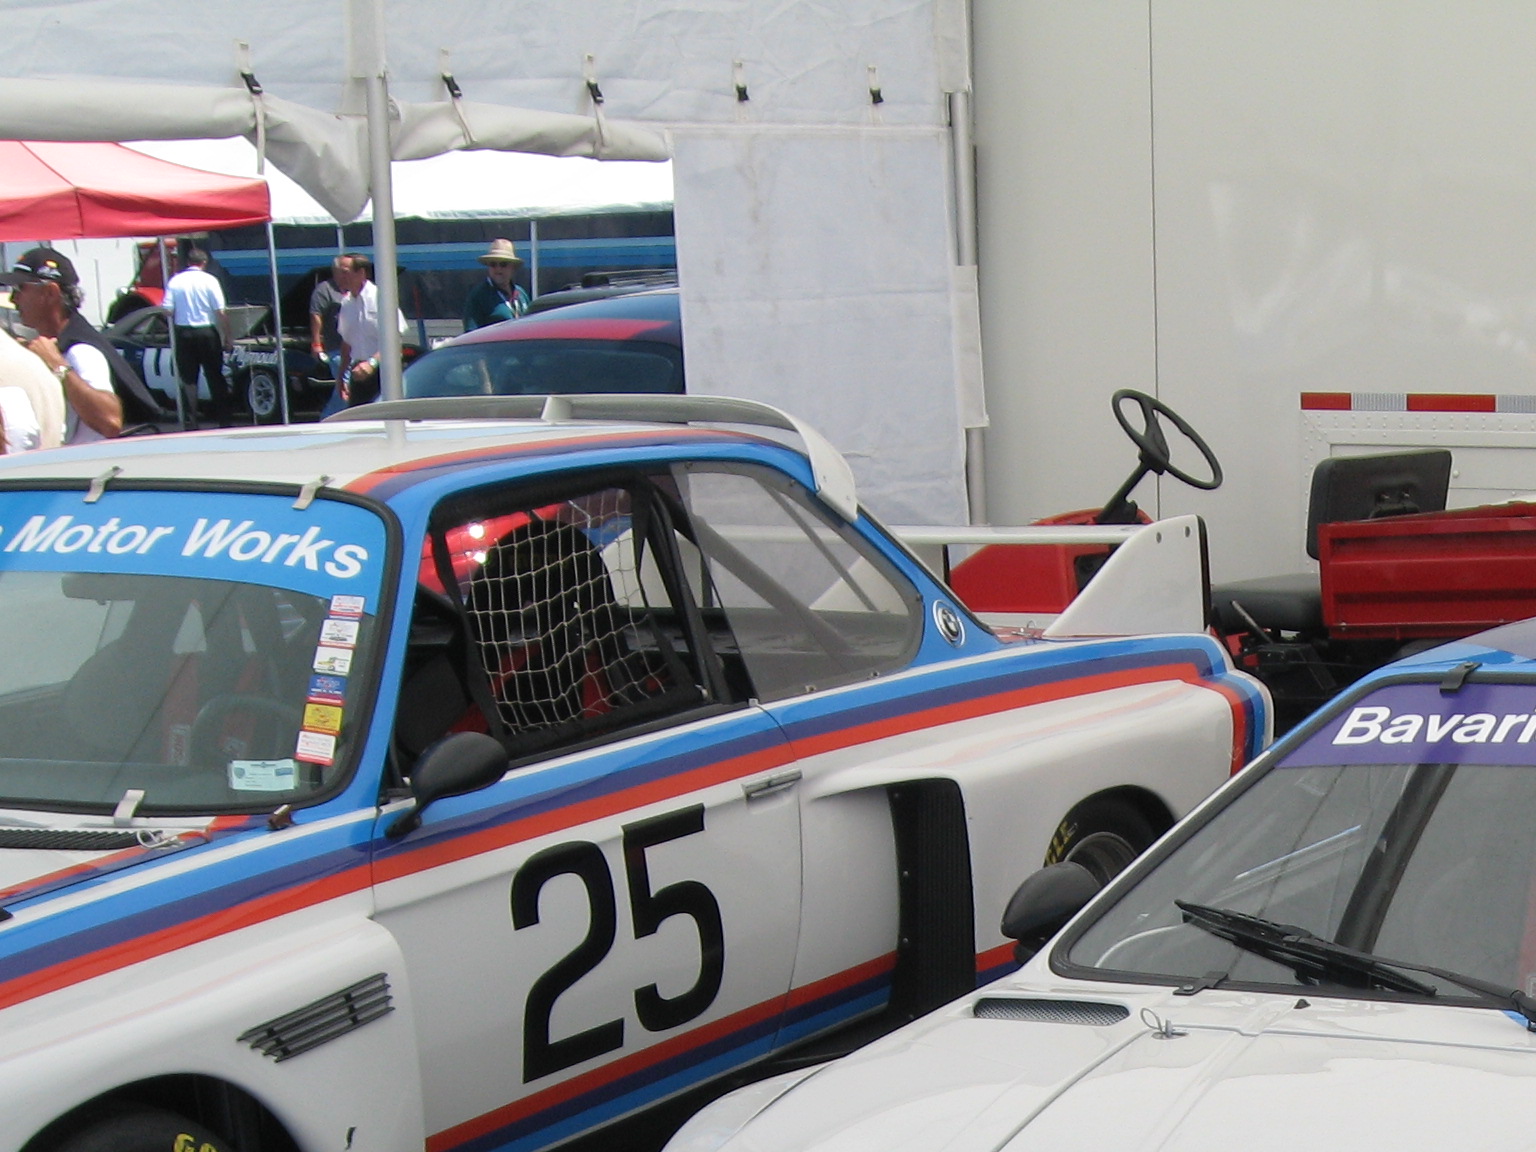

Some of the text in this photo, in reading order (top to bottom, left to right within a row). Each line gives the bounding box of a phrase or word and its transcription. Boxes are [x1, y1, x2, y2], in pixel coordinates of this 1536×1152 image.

[5, 515, 175, 555] Motor
[181, 518, 369, 579] Works
[510, 802, 725, 1084] 25
